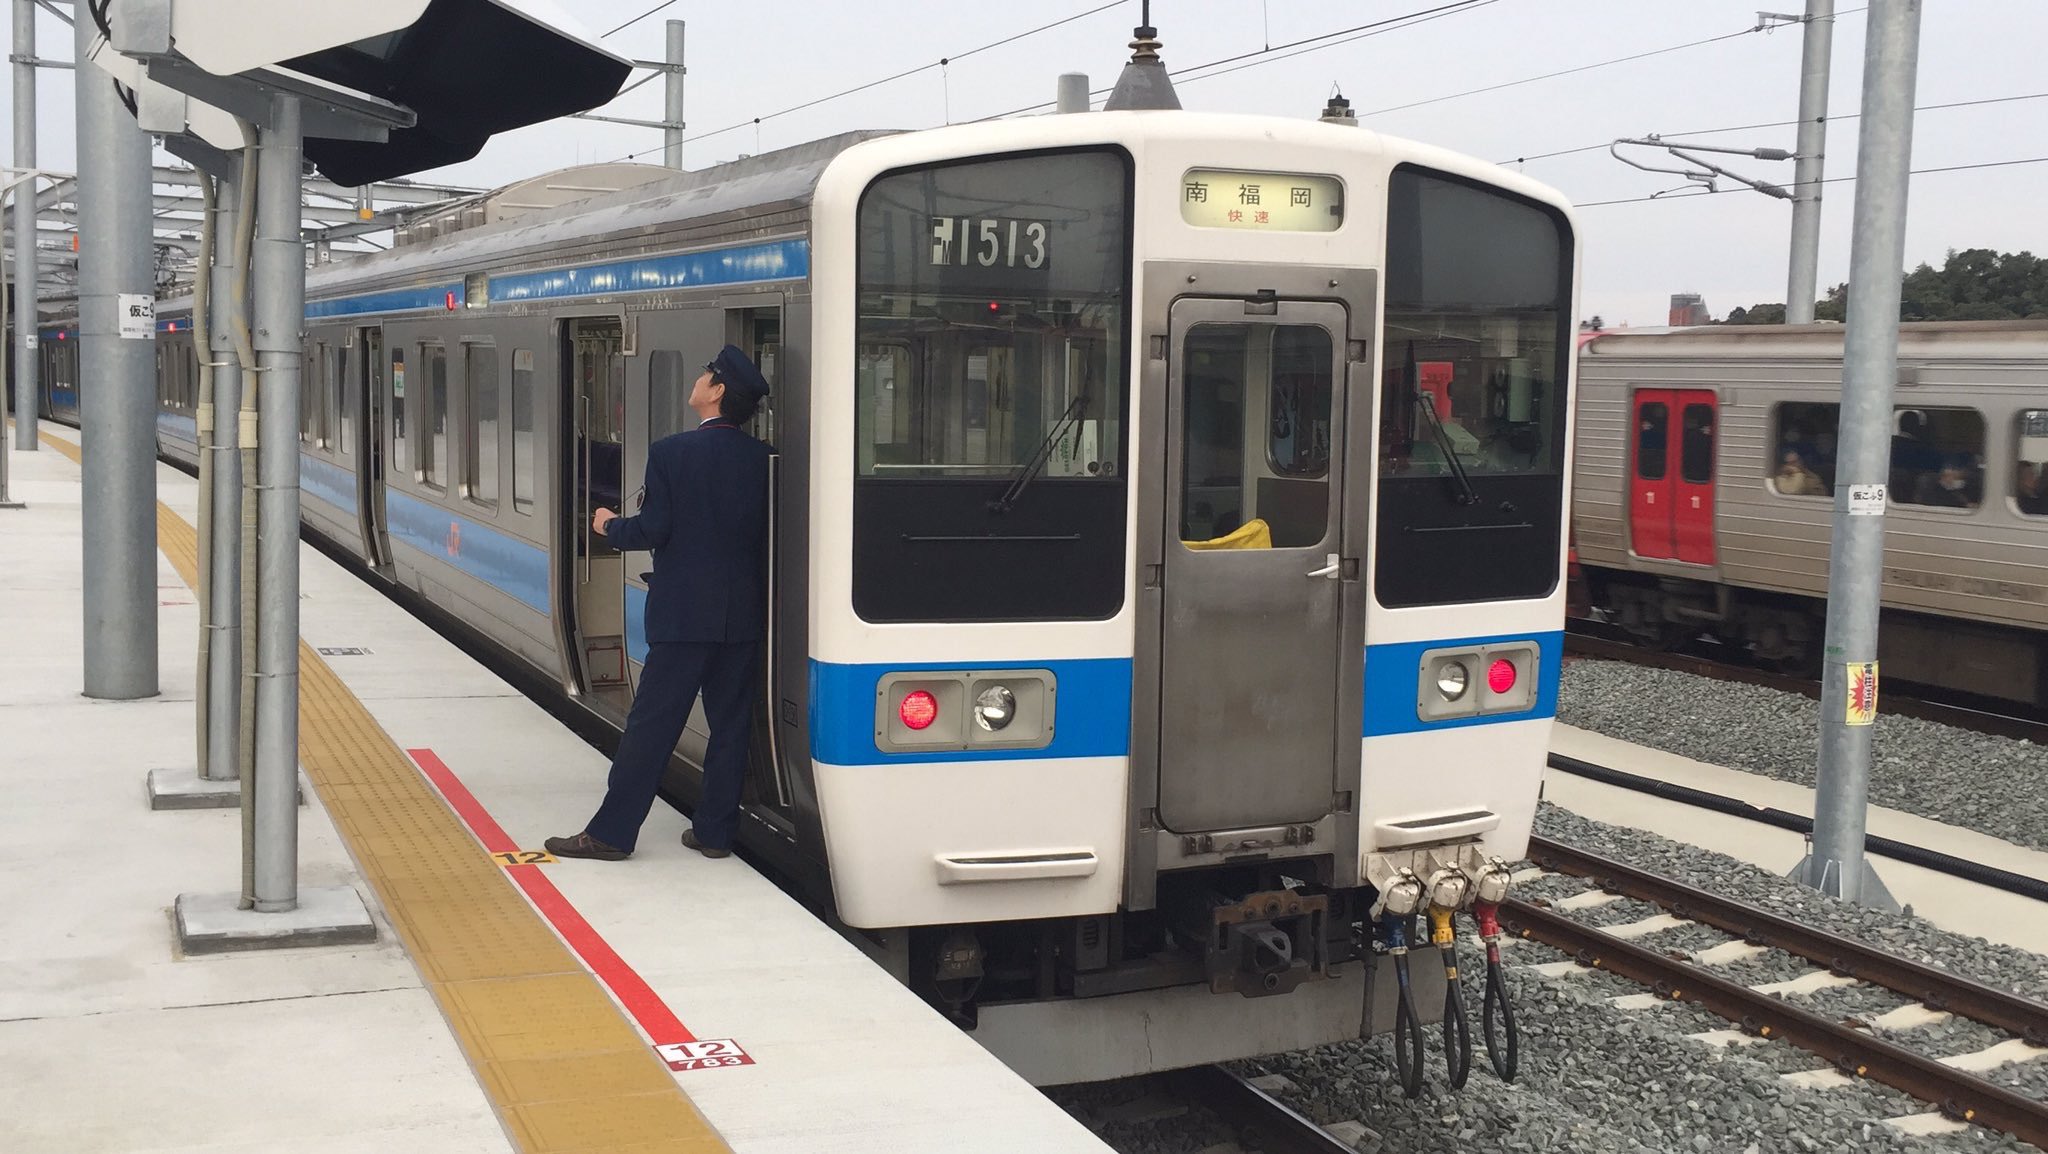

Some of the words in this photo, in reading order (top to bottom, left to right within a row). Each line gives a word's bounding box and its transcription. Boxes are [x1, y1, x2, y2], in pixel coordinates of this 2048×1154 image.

[1185, 181, 1311, 207] 南福岡
[1228, 209, 1269, 224] 快速
[495, 851, 551, 864] 12
[669, 1042, 732, 1058] 12
[678, 1056, 743, 1070] 783
